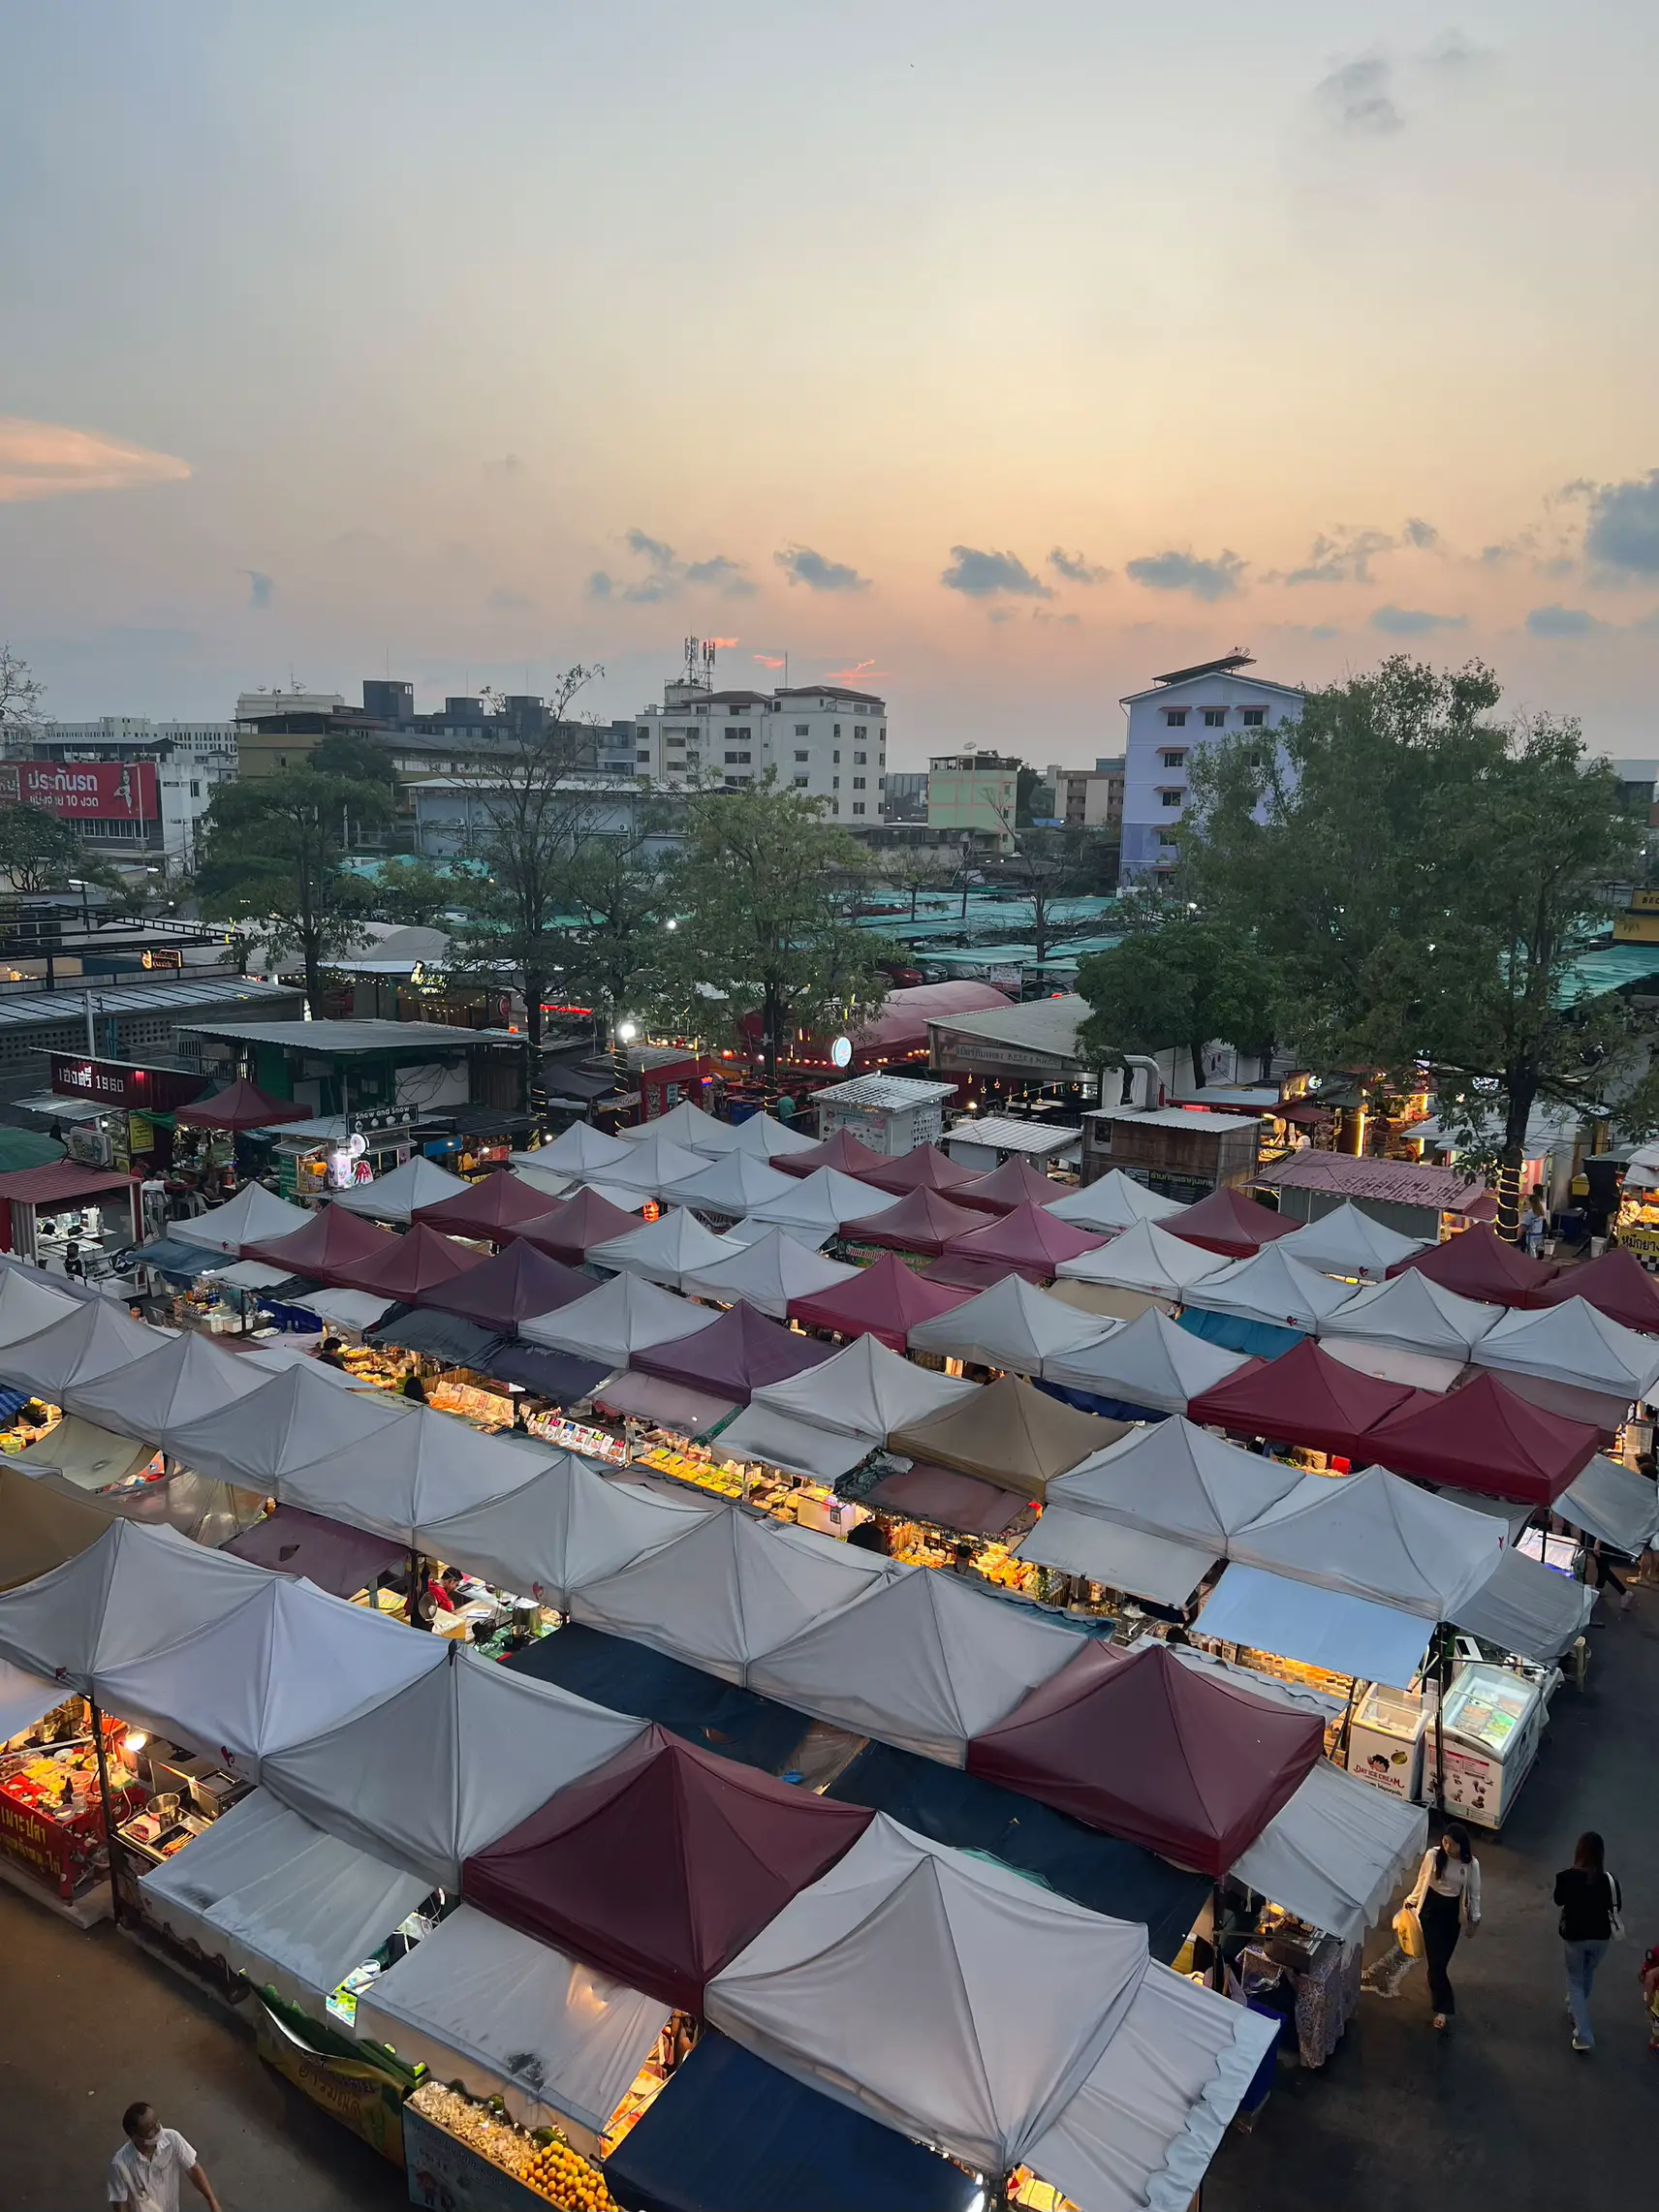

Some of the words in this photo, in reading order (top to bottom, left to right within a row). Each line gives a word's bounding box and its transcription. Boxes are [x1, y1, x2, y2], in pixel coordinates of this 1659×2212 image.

[27, 766, 98, 792] ประกันรถ
[66, 794, 78, 807] 10
[80, 795, 99, 808] งวด
[95, 1075, 124, 1093] 1960
[355, 1111, 374, 1120] Snow
[391, 1106, 409, 1114] Snow
[1353, 1763, 1367, 1774] DAY
[1378, 1773, 1405, 1789] CREAM
